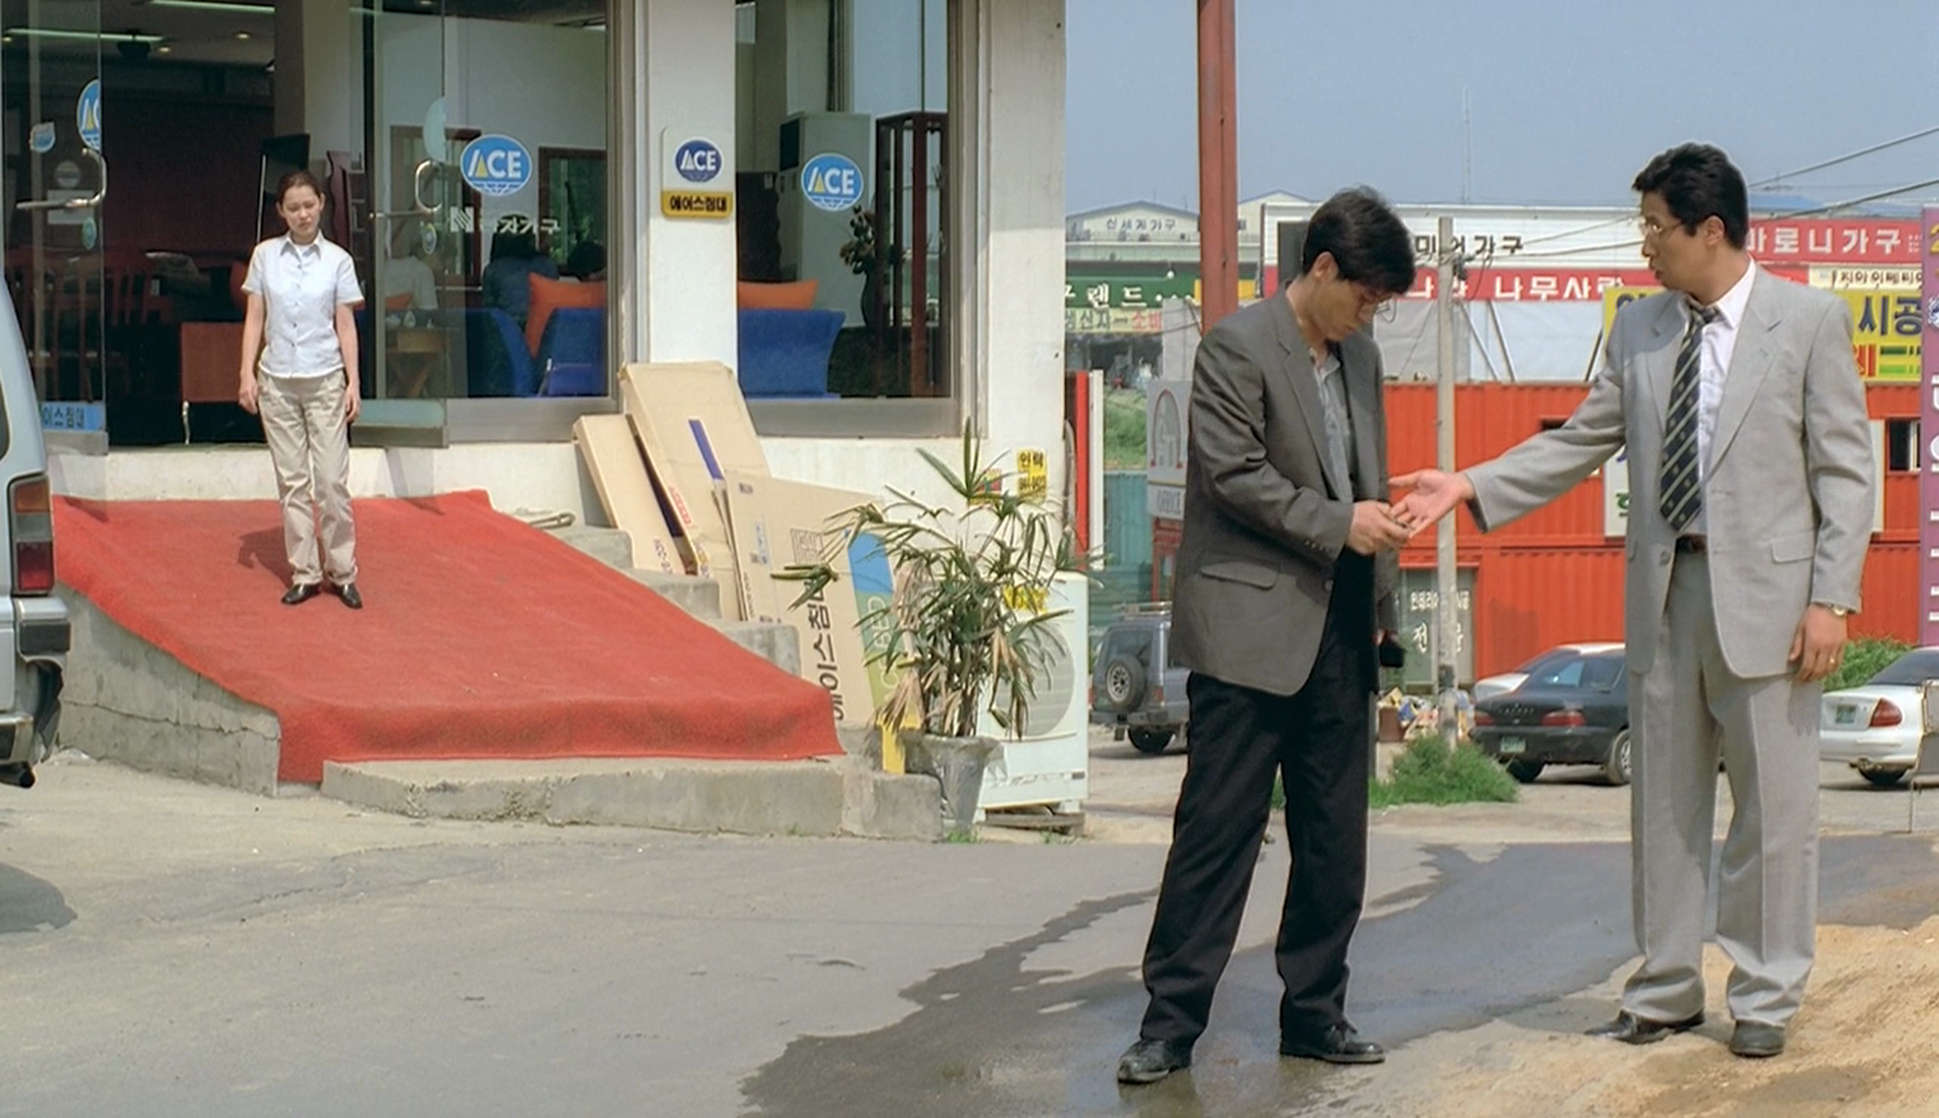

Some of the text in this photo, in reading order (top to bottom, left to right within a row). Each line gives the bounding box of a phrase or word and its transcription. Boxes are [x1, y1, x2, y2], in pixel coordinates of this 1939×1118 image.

[467, 149, 522, 179] ACE
[680, 150, 717, 171] ACE
[807, 168, 855, 195] ACE
[669, 197, 727, 212] 에이스침대
[1106, 217, 1177, 231] 신세계가구
[1415, 235, 1523, 255] 미어가구
[1132, 310, 1162, 330] 소비
[41, 406, 85, 429] 이스침대
